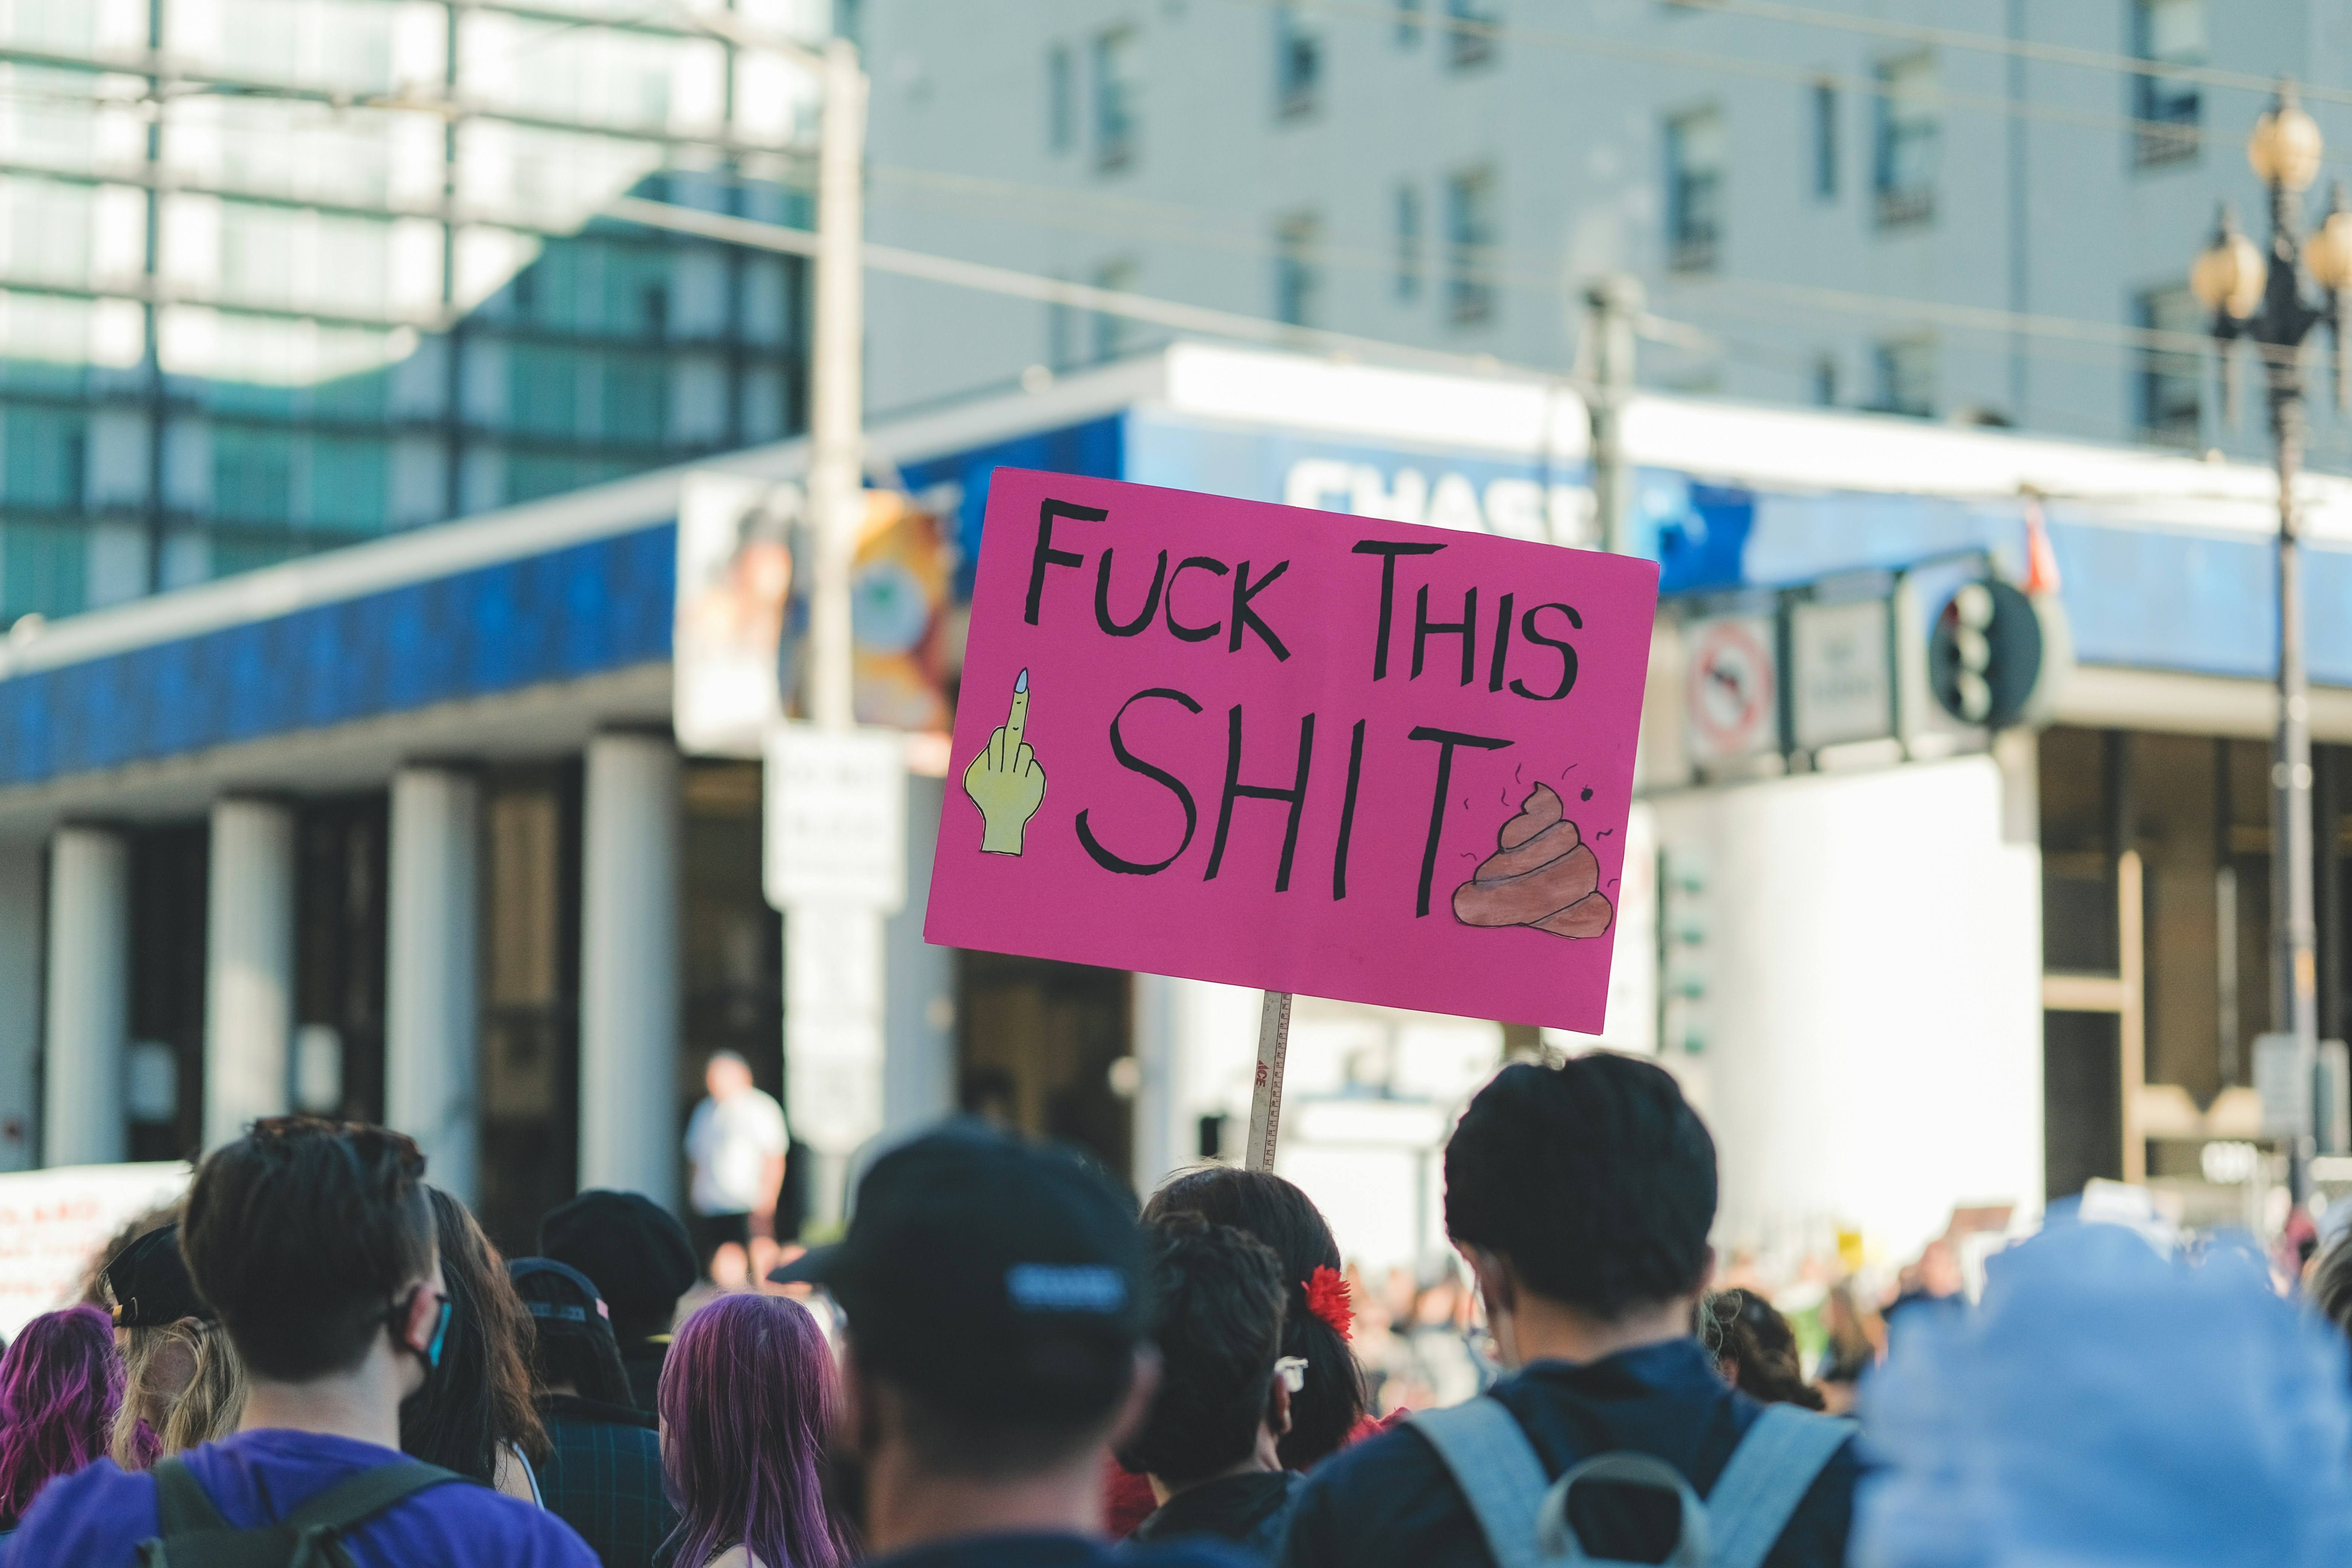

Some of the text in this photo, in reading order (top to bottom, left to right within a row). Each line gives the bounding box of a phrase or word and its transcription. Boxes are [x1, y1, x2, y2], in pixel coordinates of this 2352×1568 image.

[1024, 498, 1583, 701] FUCK THIS
[1075, 687, 1515, 919] SHIT
[1256, 1060, 1269, 1087] ACE
